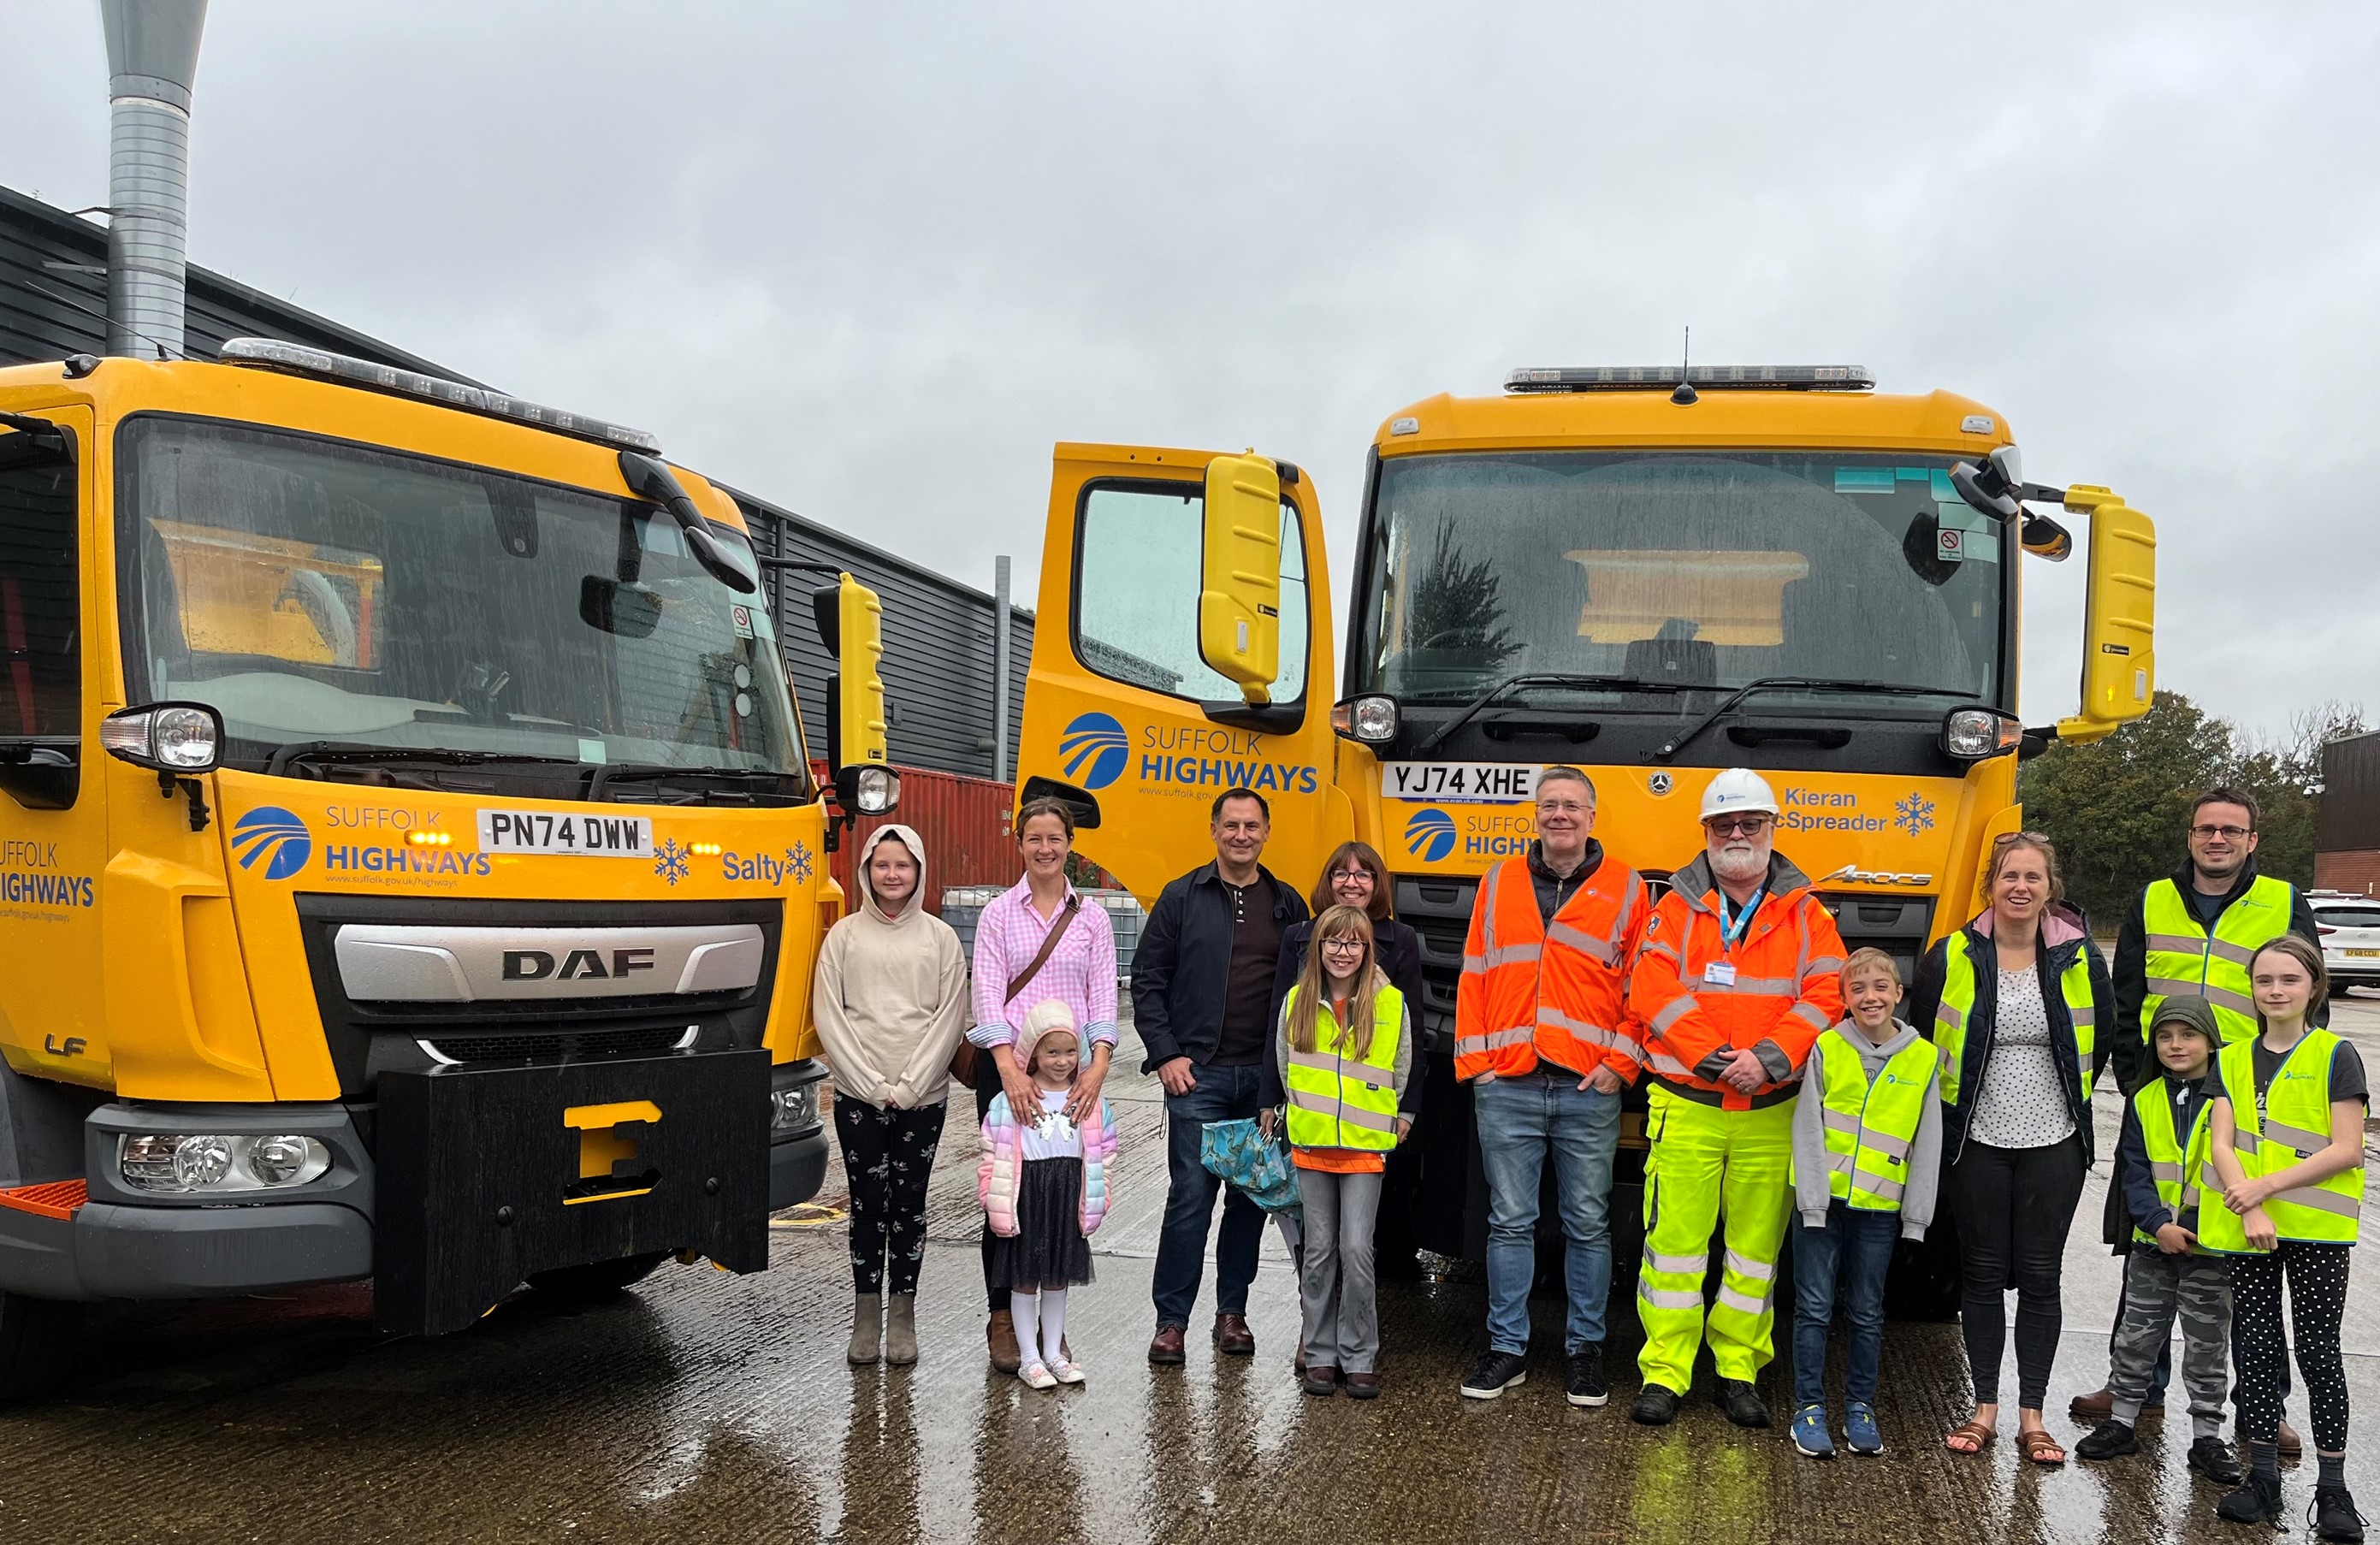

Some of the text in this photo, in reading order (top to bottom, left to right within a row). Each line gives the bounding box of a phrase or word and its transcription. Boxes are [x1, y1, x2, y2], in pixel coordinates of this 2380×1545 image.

[1143, 725, 1263, 756] SUFFOLK
[1140, 754, 1317, 794] HIGHWAYS
[1395, 767, 1530, 795] YJ74 XHE
[1785, 788, 1856, 807] Kieran
[327, 806, 441, 830] SUFFOLK
[492, 814, 638, 849] PN74 DWW
[1466, 815, 1538, 833] SUFFOL
[1775, 812, 1887, 832] cSpreader
[0, 841, 57, 867] UFFOLK
[1465, 835, 1532, 855] HIGH
[326, 845, 491, 876] HIGHWAYS
[723, 852, 784, 886] Salty
[0, 873, 94, 908] IGHWAYS
[325, 874, 458, 889] www.suffolk.gov.uk/highways
[502, 948, 654, 980] DAF
[44, 1033, 86, 1057] LF
